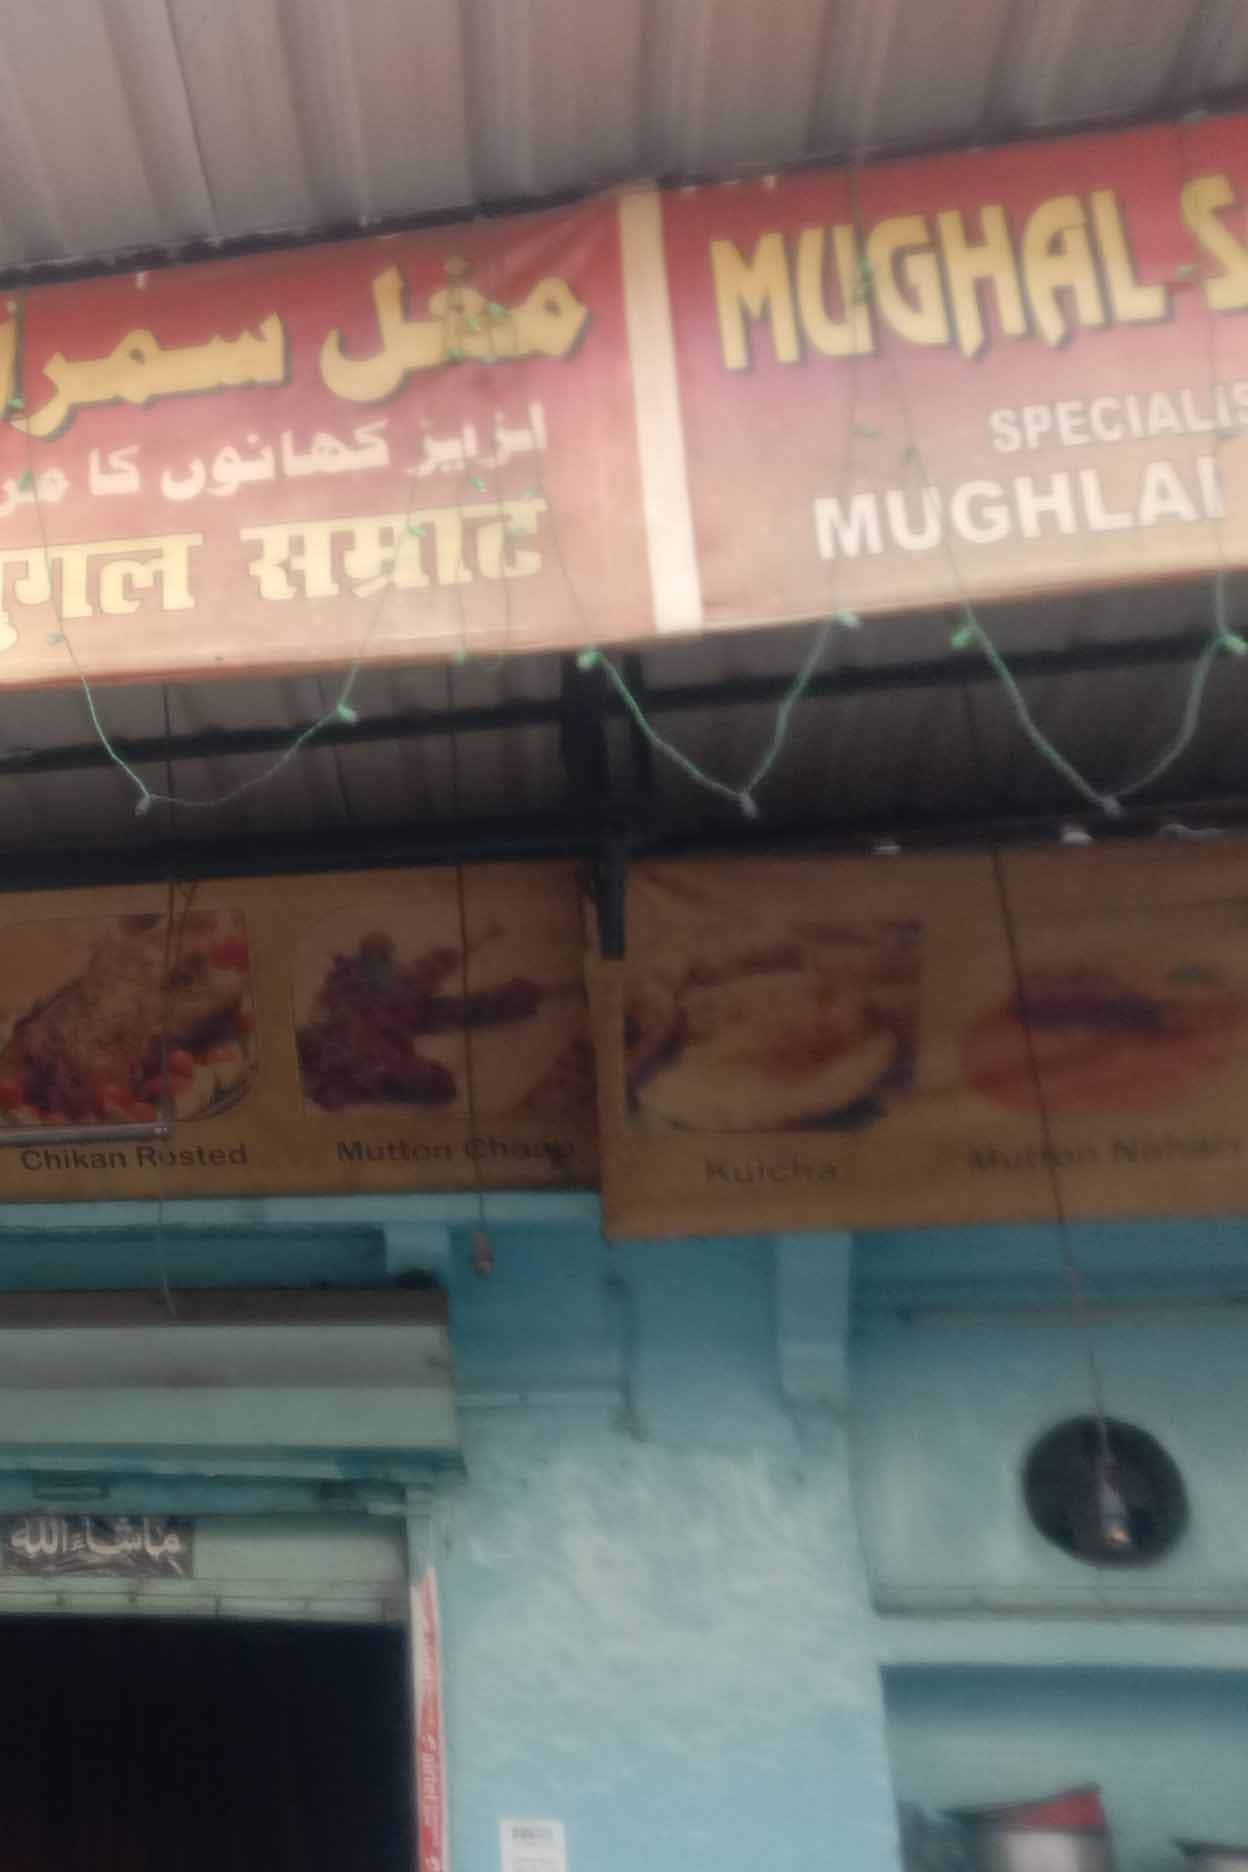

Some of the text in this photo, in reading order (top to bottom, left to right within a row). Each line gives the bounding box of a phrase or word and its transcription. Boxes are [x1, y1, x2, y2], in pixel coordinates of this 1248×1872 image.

[710, 189, 1166, 370] MUGHAL
[319, 256, 588, 402] مغل
[88, 444, 141, 496] کا
[160, 417, 391, 501] کھانوں
[240, 498, 548, 600] सम्राट
[811, 455, 1227, 560] MUGHLAI
[21, 1147, 129, 1172] Chikan
[337, 1140, 453, 1162] Mutton
